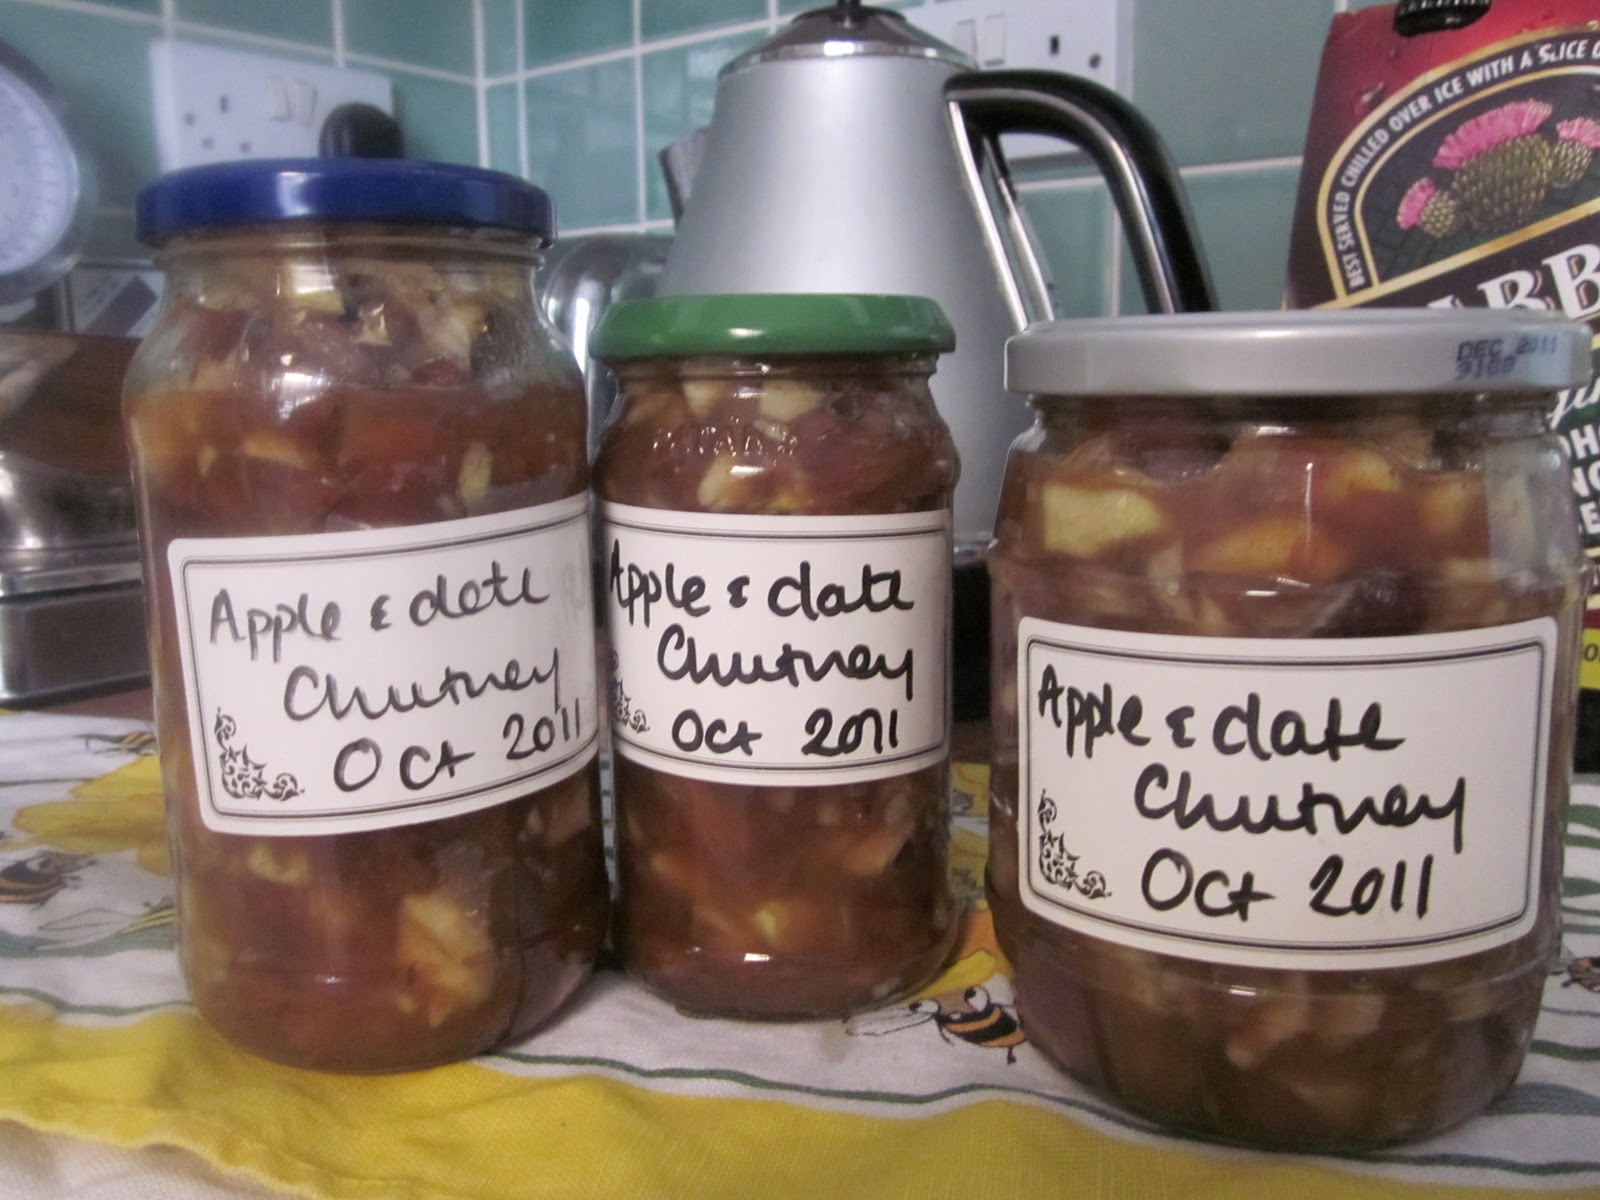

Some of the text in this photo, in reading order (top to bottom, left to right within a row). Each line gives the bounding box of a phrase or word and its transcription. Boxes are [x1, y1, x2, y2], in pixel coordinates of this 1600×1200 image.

[1466, 55, 1514, 87] WITH
[1520, 50, 1534, 70] A
[1538, 39, 1589, 64] SLICE
[1388, 95, 1433, 132] OVER
[1434, 76, 1464, 104] ICE
[1341, 128, 1390, 187] CHILLED
[1333, 191, 1355, 251] SERVED
[1342, 252, 1366, 288] BEST
[1457, 338, 1504, 361] DEC
[209, 588, 342, 663] Apple
[409, 561, 550, 627] date
[610, 538, 711, 628] Apple
[767, 560, 914, 621] date
[284, 647, 561, 722] Chutney
[657, 623, 913, 702] Chutney
[672, 707, 899, 756] Oct 2011
[1038, 663, 1151, 759] Apple
[1212, 692, 1406, 761] date
[333, 698, 581, 792] Oct 2011
[1134, 762, 1466, 854] Chutney
[1141, 847, 1433, 921] Oct 2011
